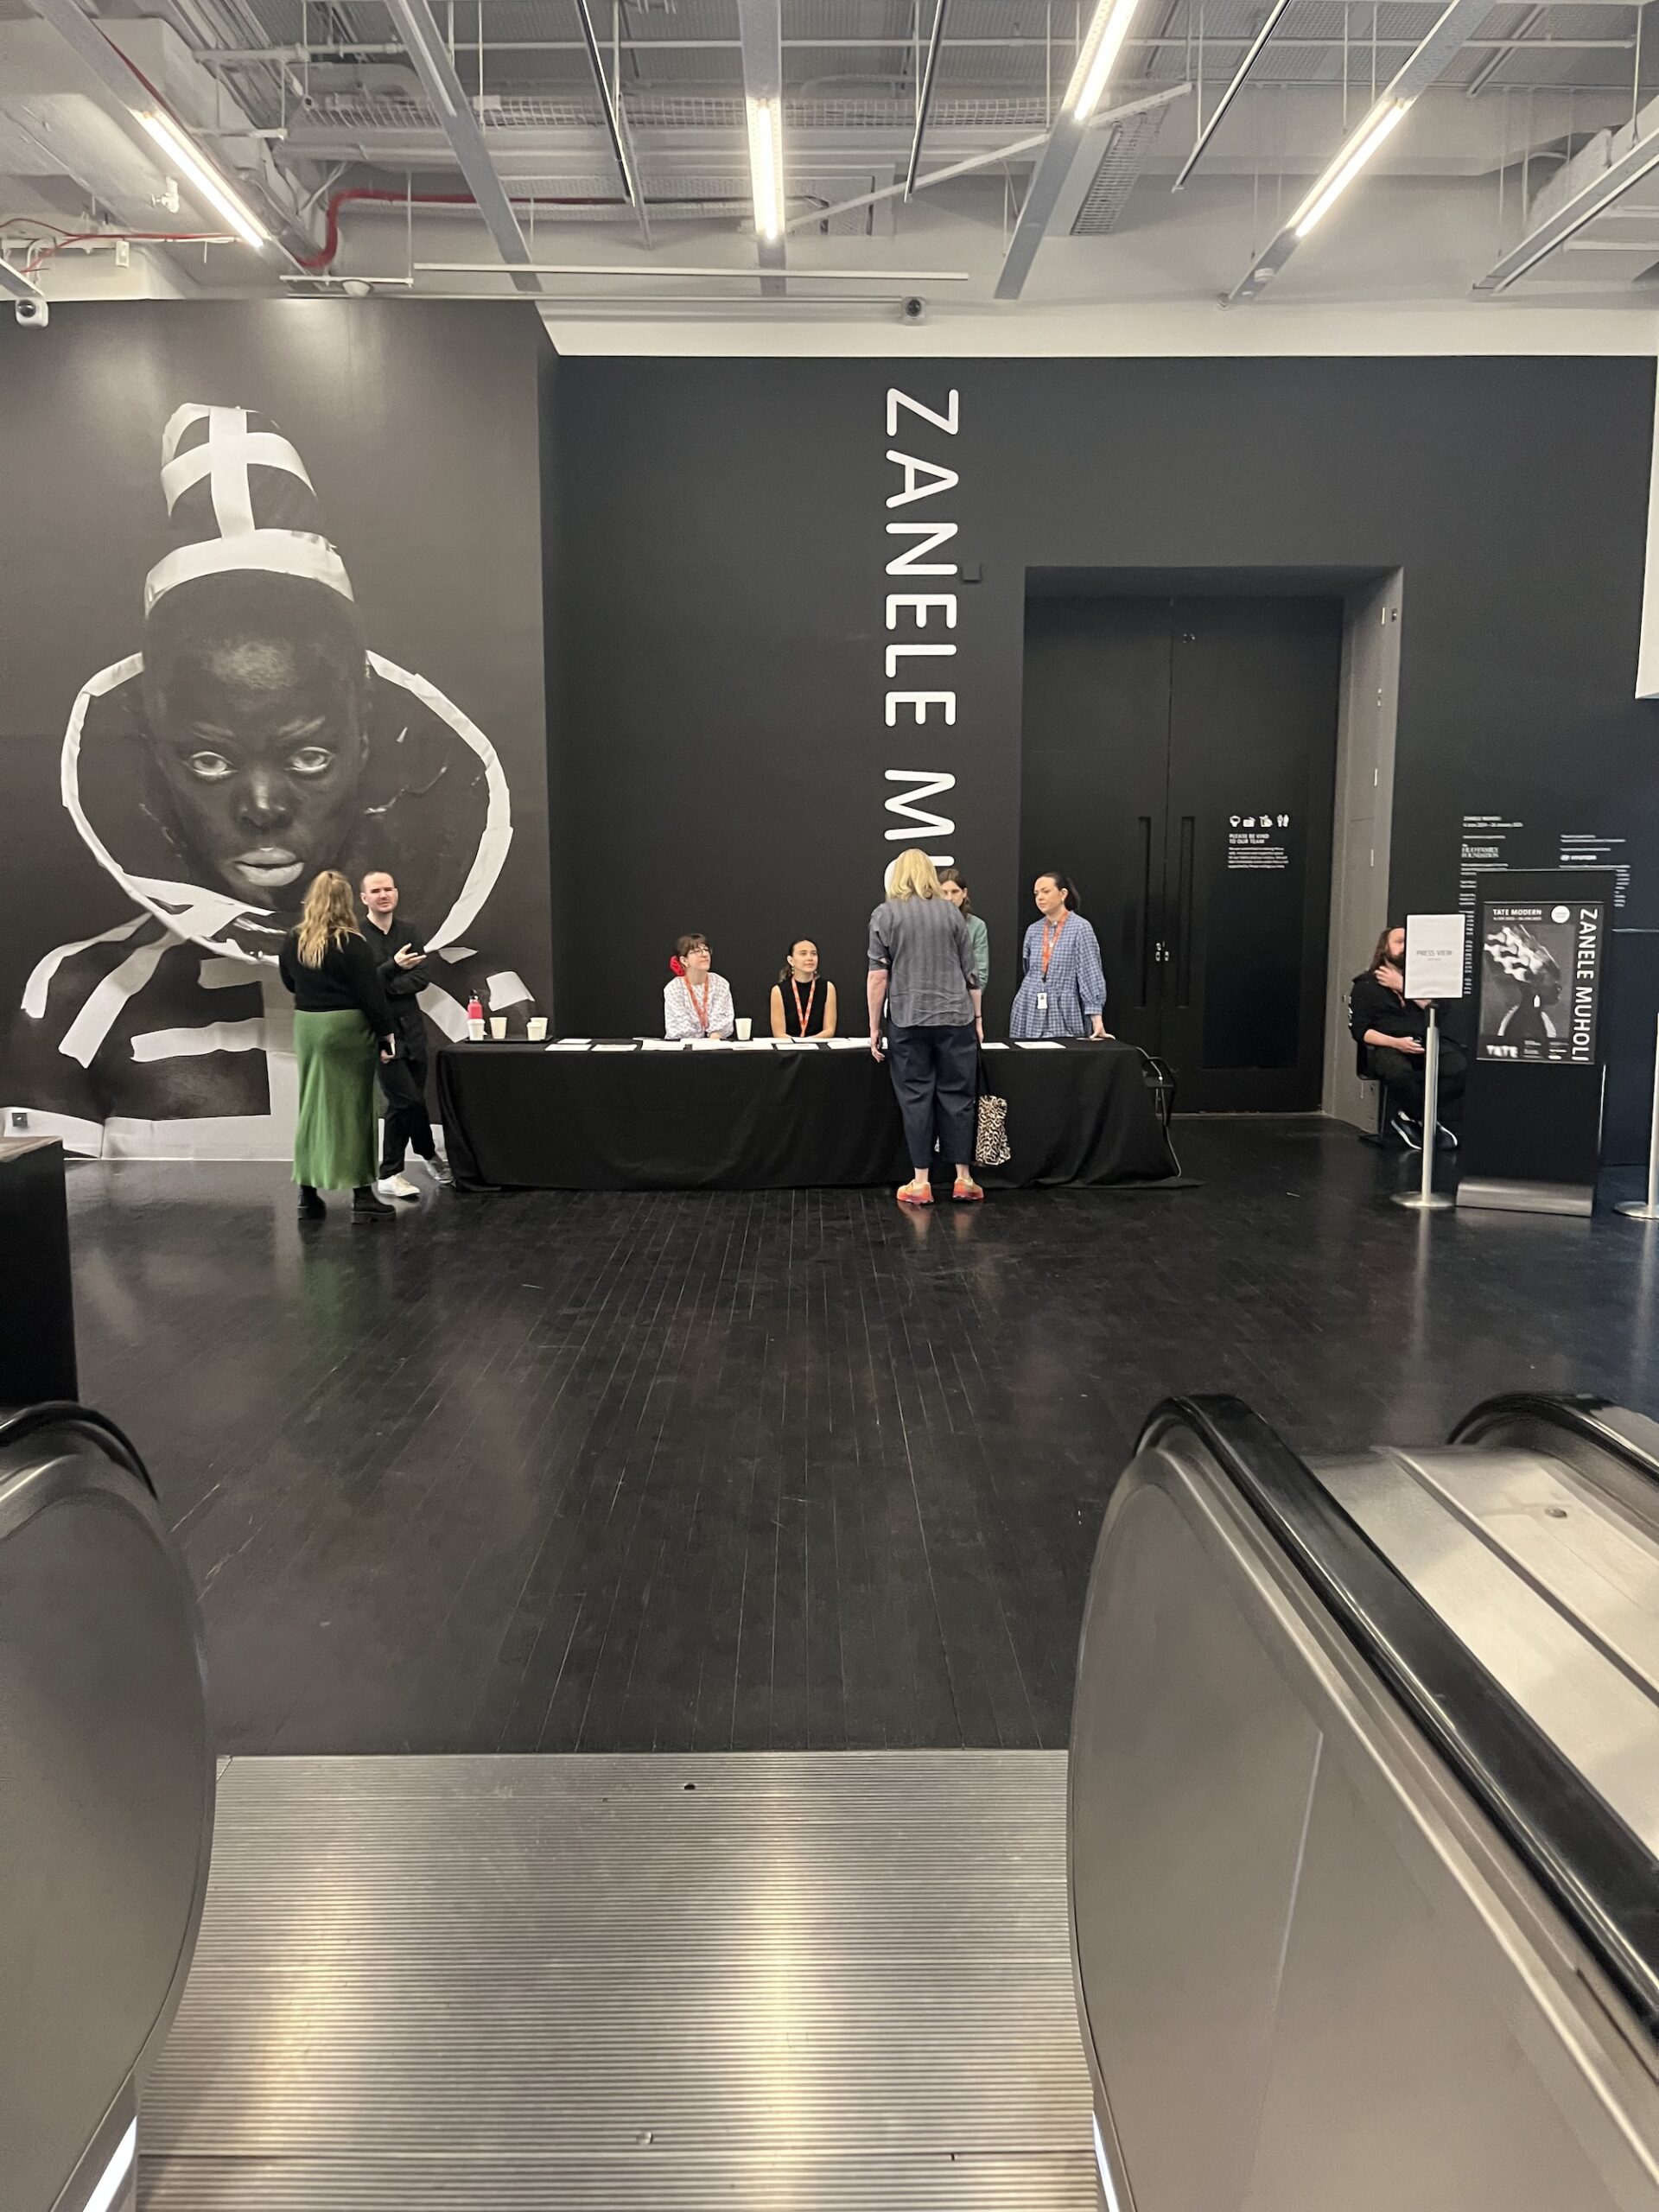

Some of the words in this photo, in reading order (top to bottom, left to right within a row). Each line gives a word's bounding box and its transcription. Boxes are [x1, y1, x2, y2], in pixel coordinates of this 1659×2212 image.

[885, 387, 959, 728] ZANELE
[1576, 908, 1599, 979] ZANELE
[1486, 1045, 1518, 1058] TATE
[1571, 987, 1593, 1061] MUHOLI
